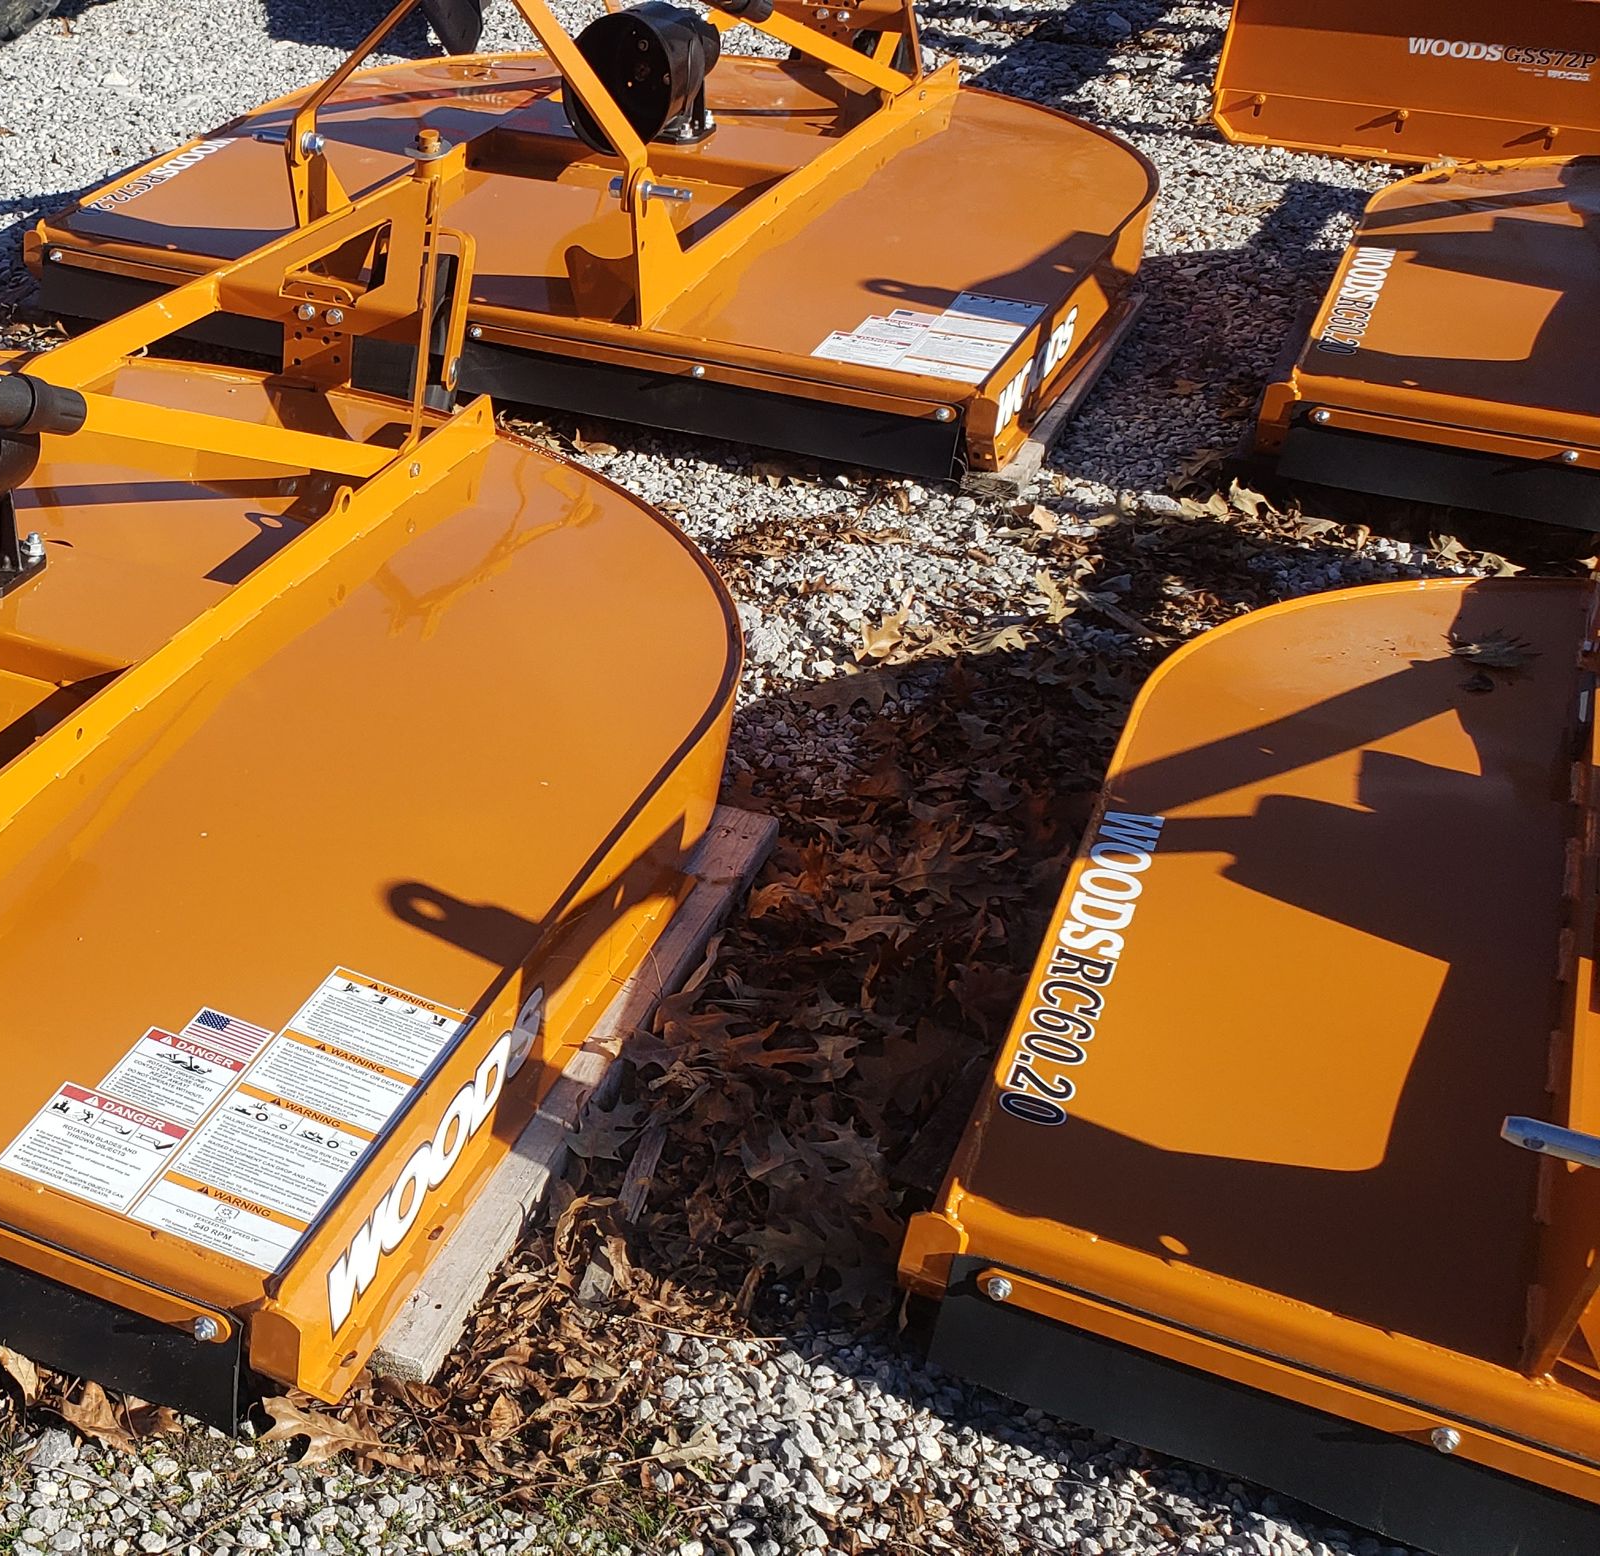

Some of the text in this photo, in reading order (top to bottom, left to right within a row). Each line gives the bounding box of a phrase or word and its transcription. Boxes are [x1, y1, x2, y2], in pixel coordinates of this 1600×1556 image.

[994, 305, 1077, 439] WOODS
[380, 986, 437, 1011] WARNING
[174, 1039, 235, 1069] DANGER
[328, 1047, 387, 1074] WARNING
[100, 1100, 167, 1131] DANGER
[282, 1101, 343, 1129] WARNING
[327, 986, 543, 1341] WOODS
[211, 1189, 273, 1218] WARNING
[191, 1221, 233, 1241] 540 RPM
